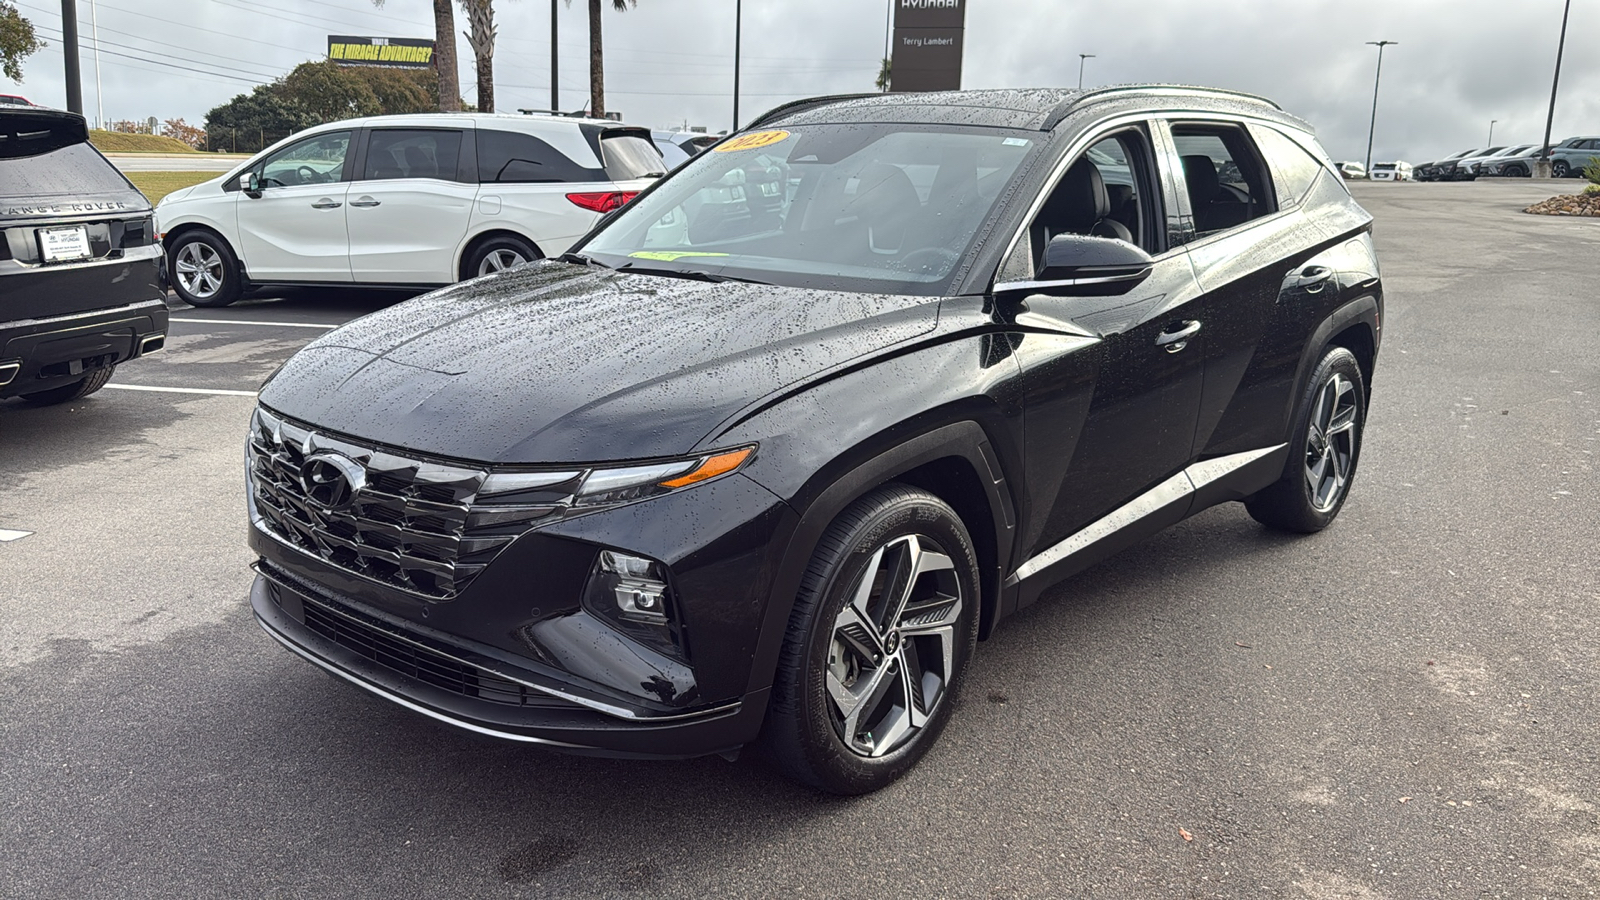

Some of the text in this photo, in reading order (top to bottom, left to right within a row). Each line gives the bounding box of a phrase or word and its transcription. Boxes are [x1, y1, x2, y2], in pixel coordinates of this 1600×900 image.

[902, 37, 953, 47] Terry Lambert
[330, 43, 432, 62] THE MIRACLE ADVANTAGE?
[0, 201, 125, 215] ANGE ROVER
